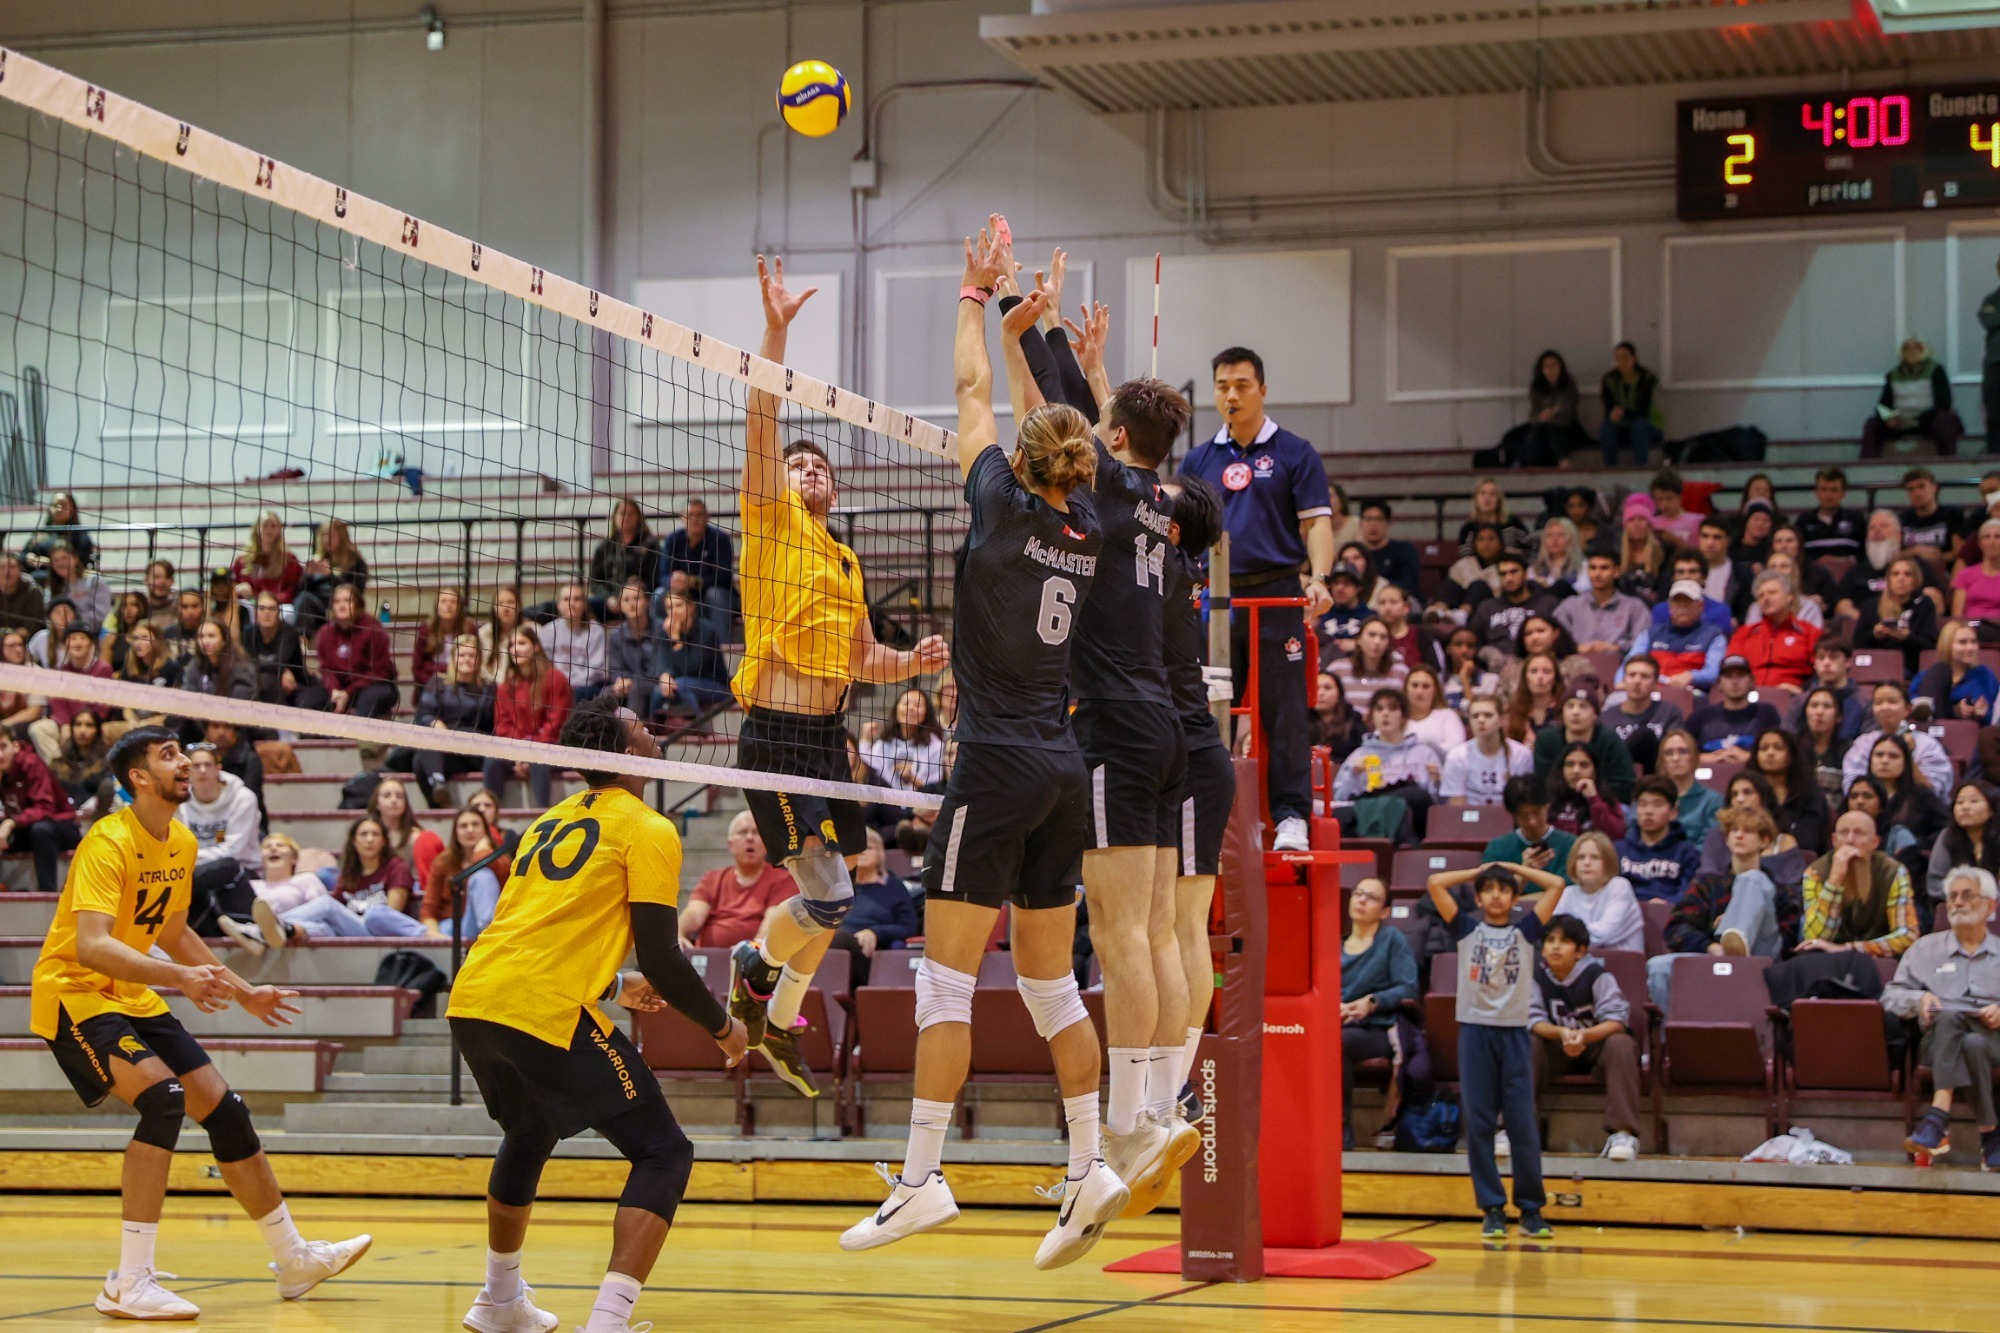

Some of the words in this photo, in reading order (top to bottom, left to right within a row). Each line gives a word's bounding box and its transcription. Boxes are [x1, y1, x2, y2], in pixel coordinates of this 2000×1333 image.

[1692, 107, 1747, 132] Home
[1802, 95, 1910, 148] 4:00
[1929, 93, 1999, 118] Guests
[1724, 134, 1755, 185] 2
[1808, 178, 1873, 206] period
[1133, 499, 1171, 537] McMASTE
[1024, 535, 1097, 577] McMASTER
[1134, 532, 1166, 597] 14
[1036, 575, 1077, 646] 6
[137, 866, 186, 884] ATERLOO
[514, 817, 601, 881] 10
[134, 886, 173, 935] 14
[69, 1024, 109, 1082] WARRIORS
[589, 1028, 637, 1100] WARRIORS
[1200, 1059, 1218, 1114] sports
[1201, 1116, 1219, 1183] imports
